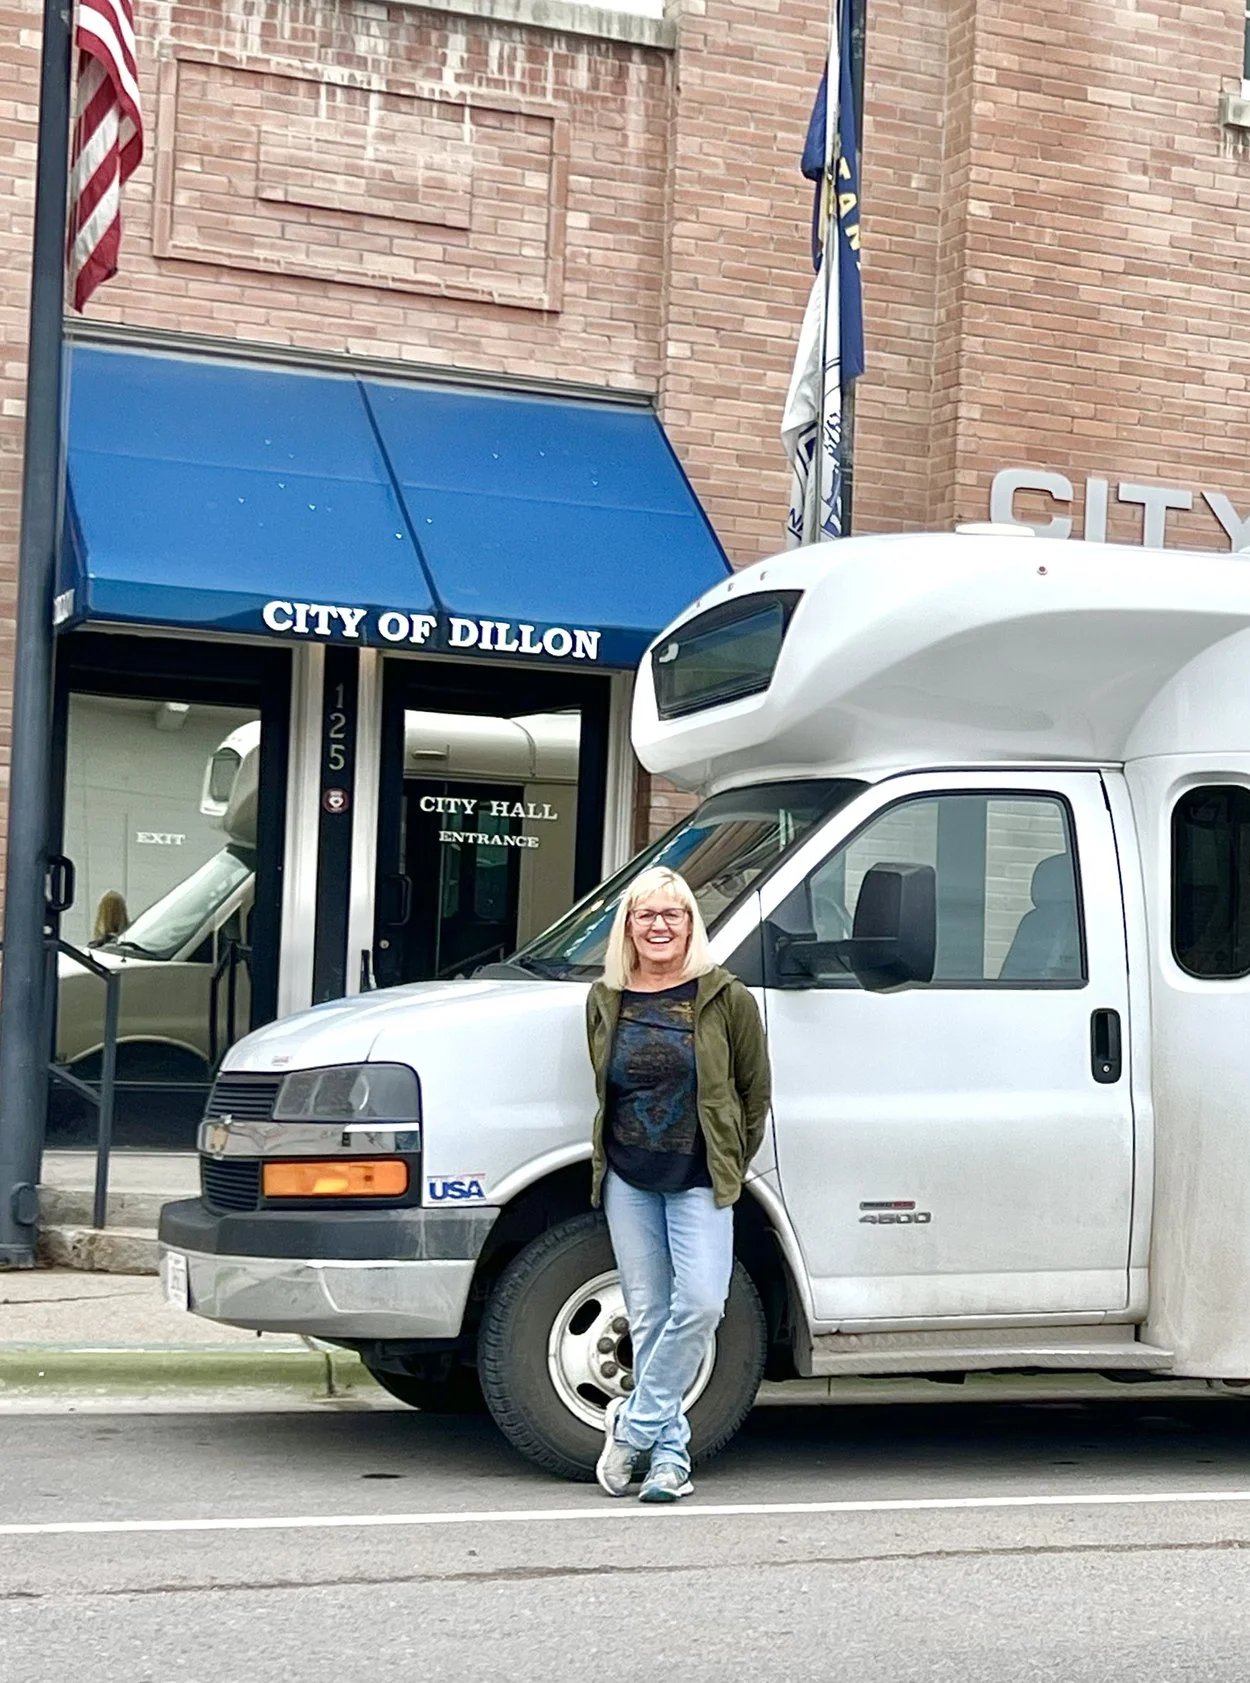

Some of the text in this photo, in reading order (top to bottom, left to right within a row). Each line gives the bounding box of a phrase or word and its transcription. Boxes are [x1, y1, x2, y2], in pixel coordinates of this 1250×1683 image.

[262, 600, 602, 660] CITY OF DILLON
[419, 796, 558, 820] CITY HALL
[136, 831, 186, 845] EXIT
[438, 830, 540, 848] ENTRANCE
[429, 1180, 486, 1200] USA
